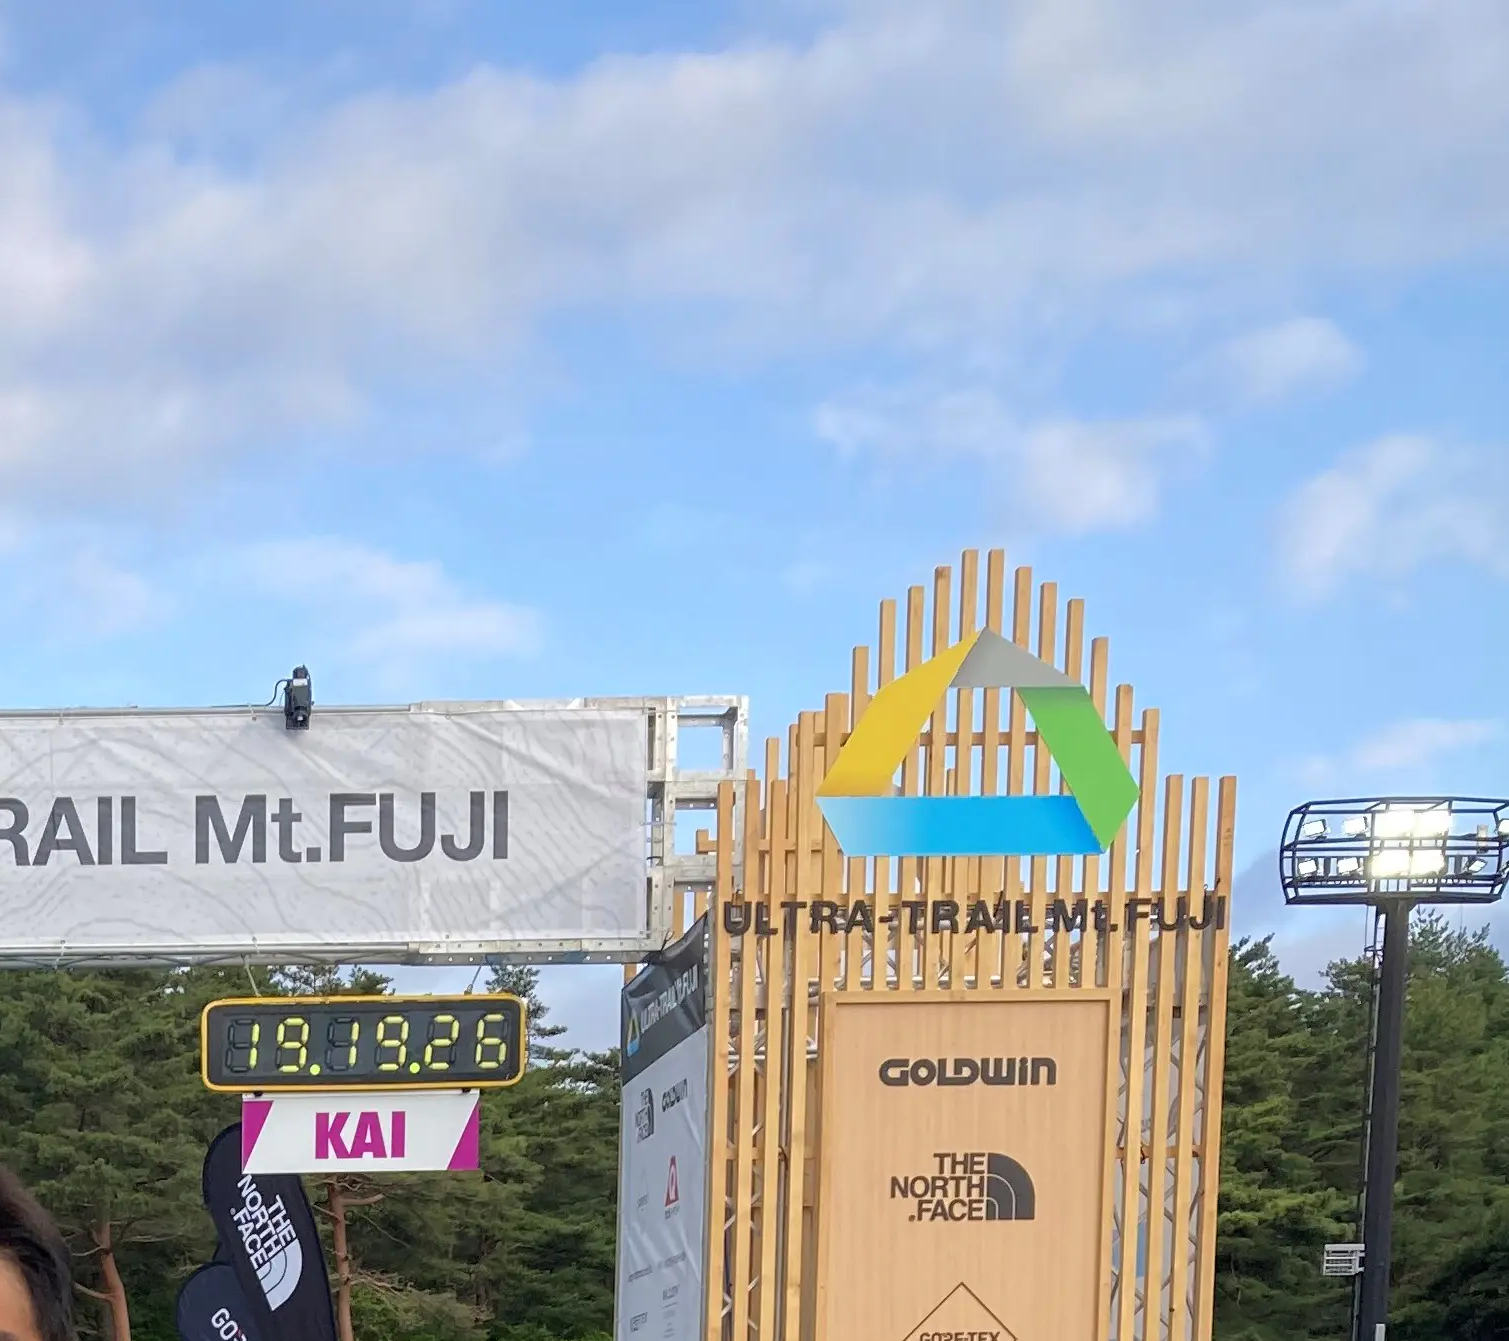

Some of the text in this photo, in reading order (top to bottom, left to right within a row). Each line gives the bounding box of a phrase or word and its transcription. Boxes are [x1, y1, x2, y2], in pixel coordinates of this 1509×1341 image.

[195, 790, 509, 864] Mt.FUJI
[723, 896, 1225, 936] ULTRA-TRAIL Mt.FUJI
[314, 1110, 406, 1160] KAI
[891, 1175, 985, 1199] NORTH
[933, 1152, 986, 1175] THE
[237, 1173, 283, 1259] NORTH
[268, 1194, 297, 1247] THE
